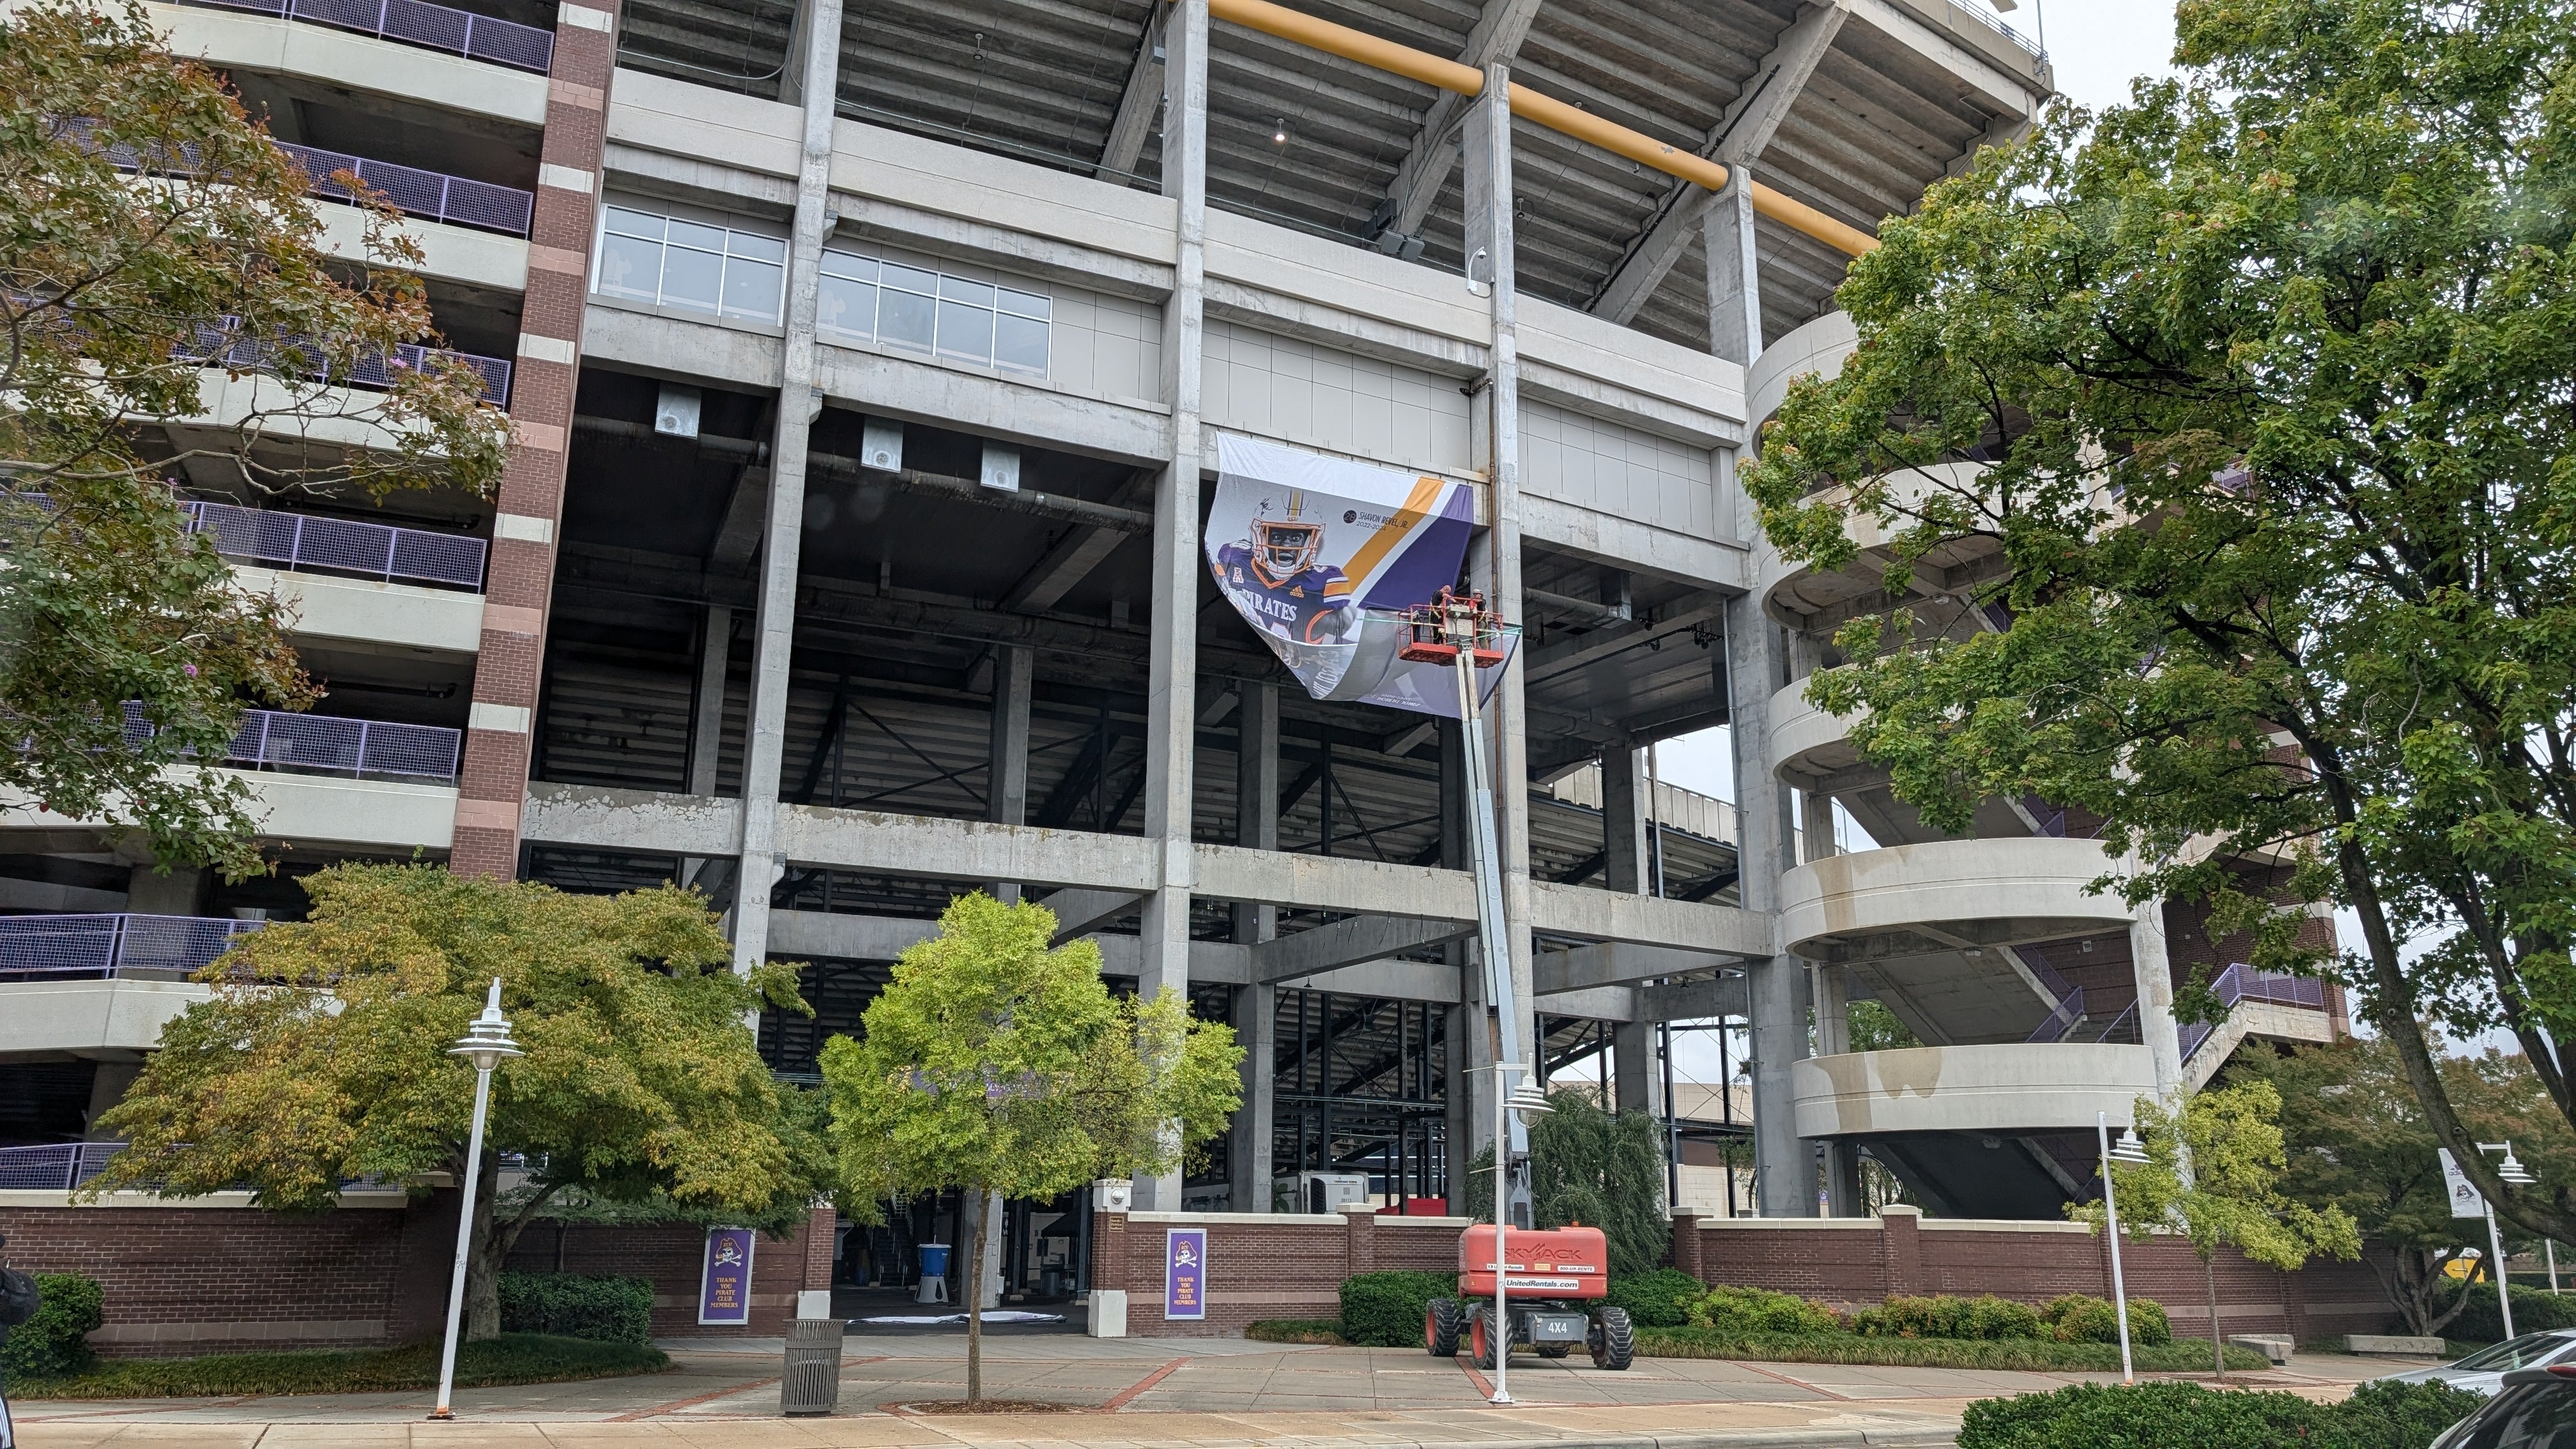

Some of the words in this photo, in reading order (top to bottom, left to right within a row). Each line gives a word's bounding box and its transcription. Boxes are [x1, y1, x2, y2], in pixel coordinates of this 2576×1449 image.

[1344, 512, 1356, 521] 28
[1358, 512, 1382, 523] SHAVON
[1381, 516, 1399, 528] REVEL,
[1399, 520, 1408, 528] JR.
[1356, 521, 1386, 531] 2022-2024
[1242, 588, 1298, 622] PIRATES
[1505, 1243, 1583, 1261] SKYJACK
[1506, 1279, 1579, 1289] UnitedRentals.com
[1547, 1322, 1568, 1333] 4X4
